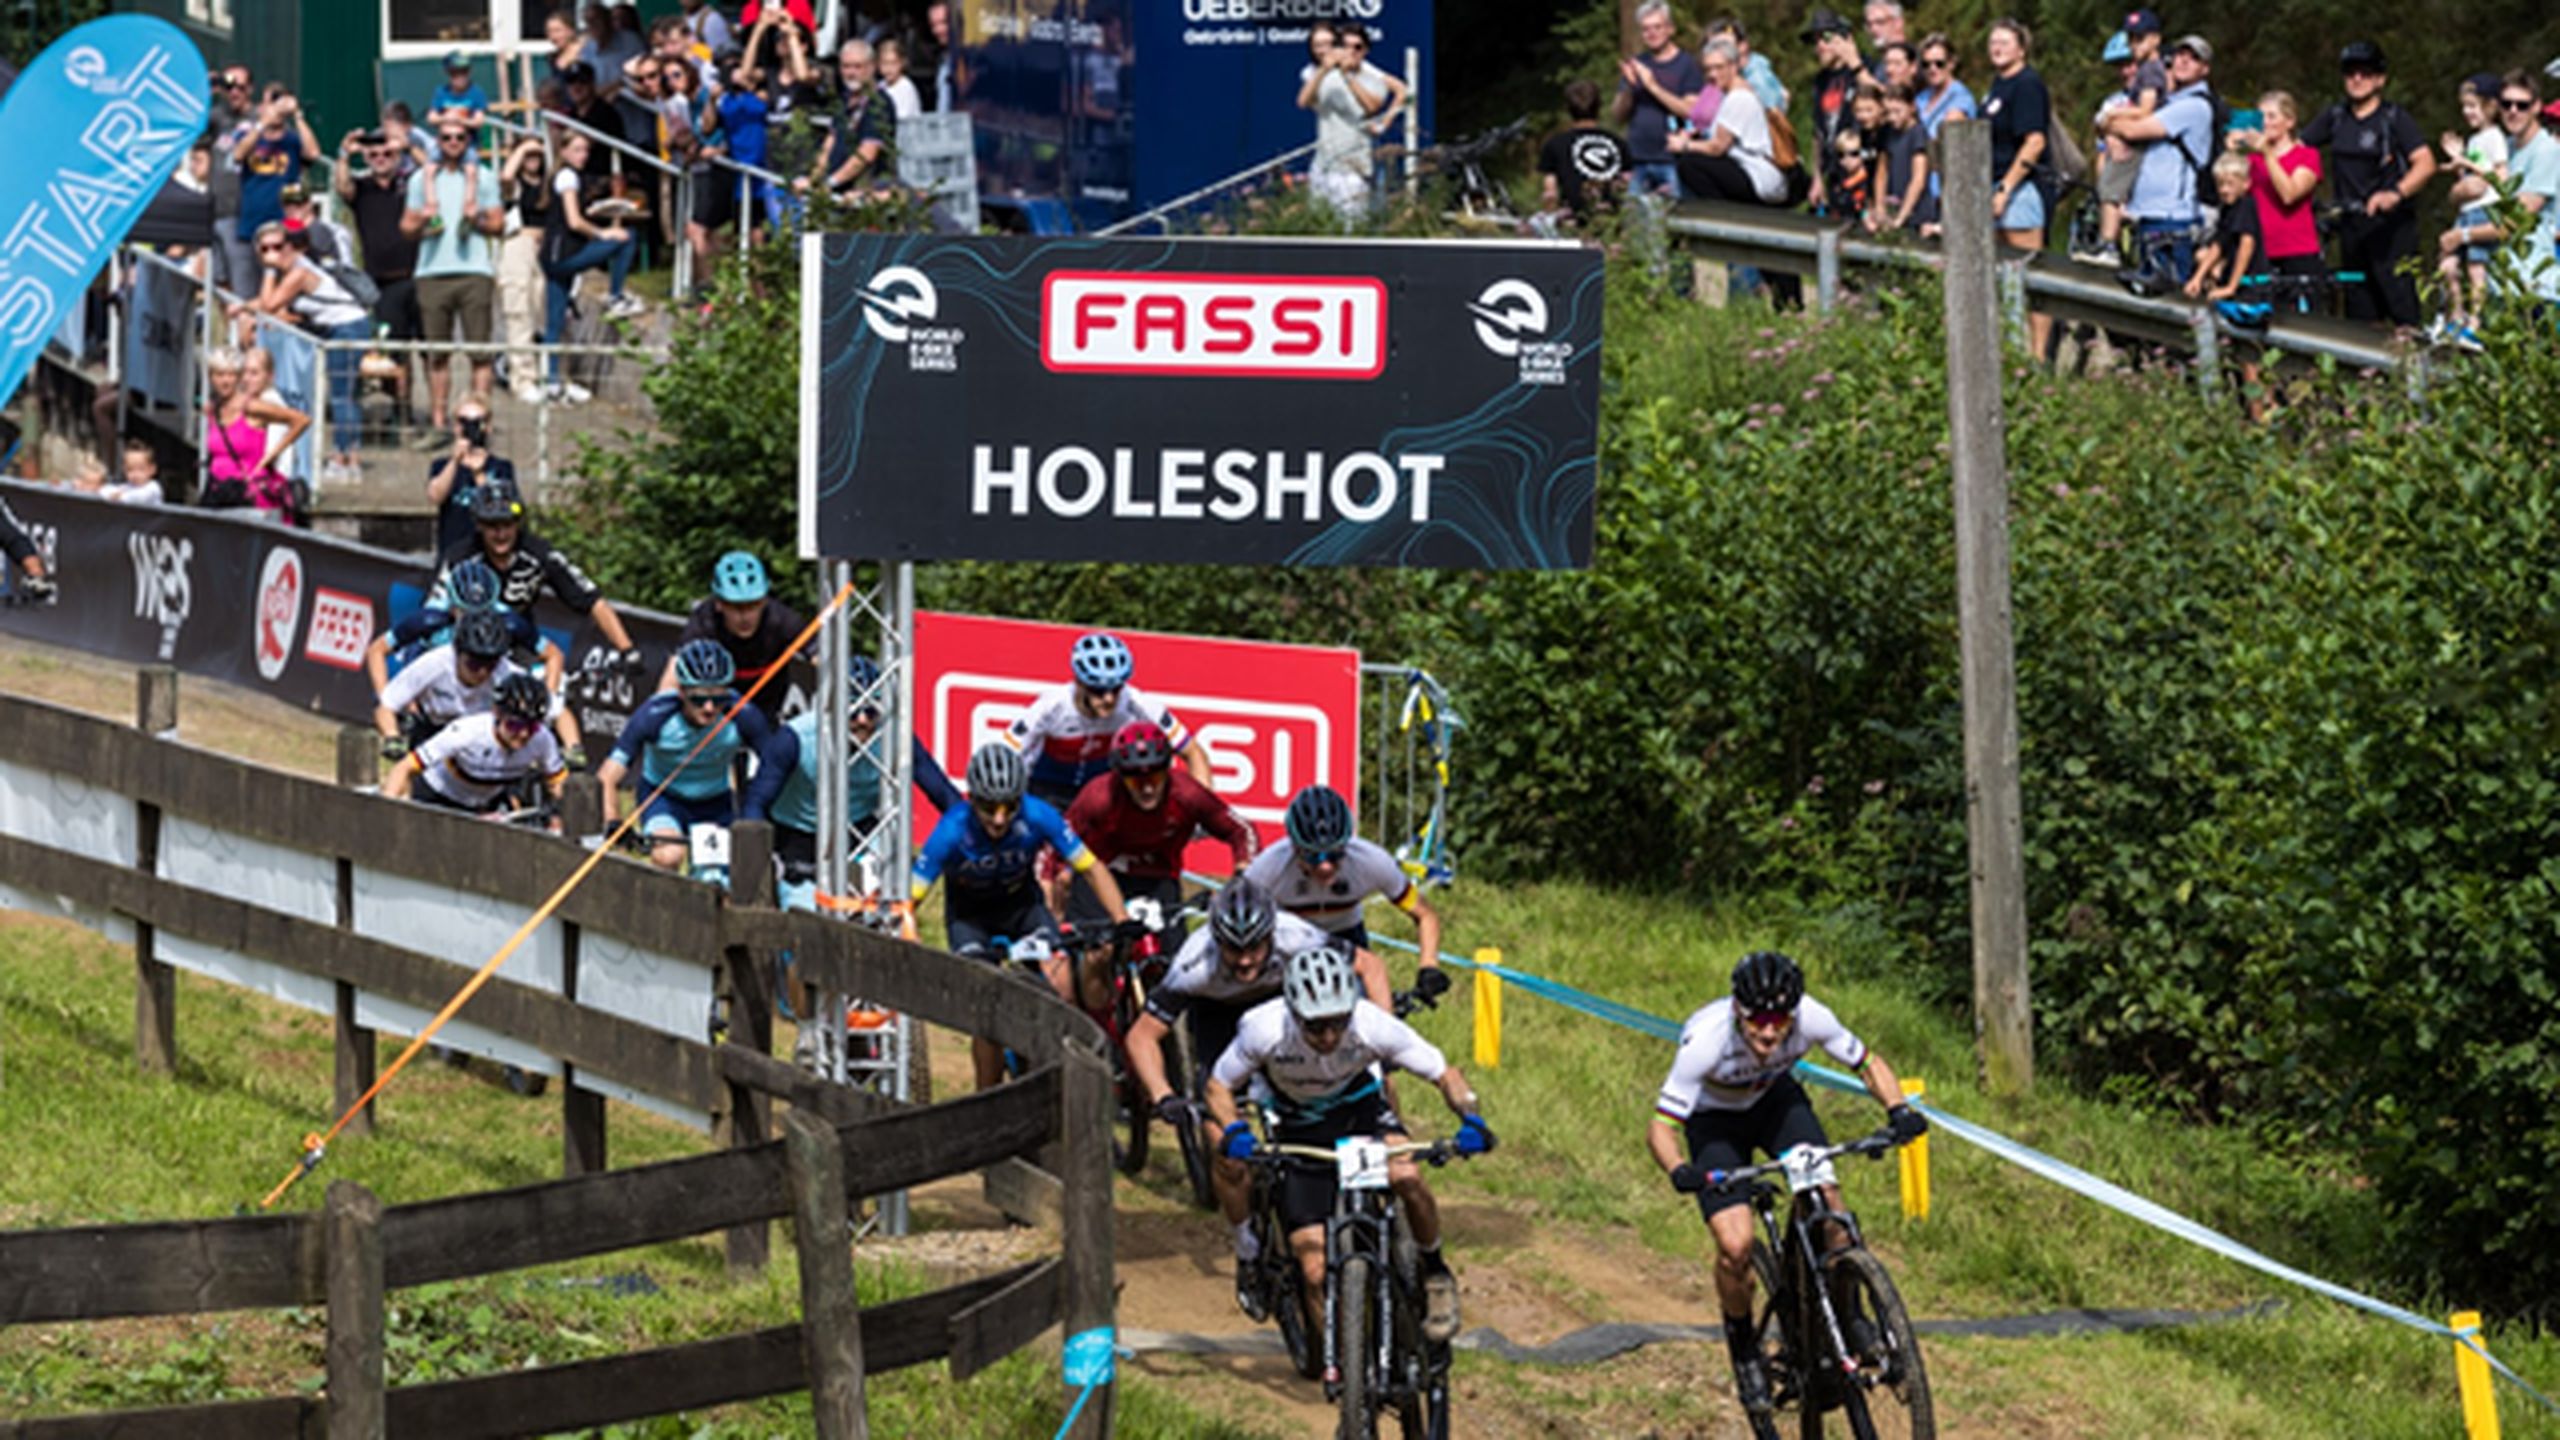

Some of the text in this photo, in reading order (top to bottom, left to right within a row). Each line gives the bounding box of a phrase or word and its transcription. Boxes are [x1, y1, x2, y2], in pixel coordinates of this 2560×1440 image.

[0, 44, 206, 348] START
[1074, 293, 1354, 356] FASSI
[910, 328, 965, 343] WORLD
[1519, 341, 1574, 357] WORLD
[910, 356, 958, 371] SERIES
[1519, 370, 1566, 384] SERIES
[972, 445, 1445, 522] HOLESHOT
[703, 832, 719, 850] 4
